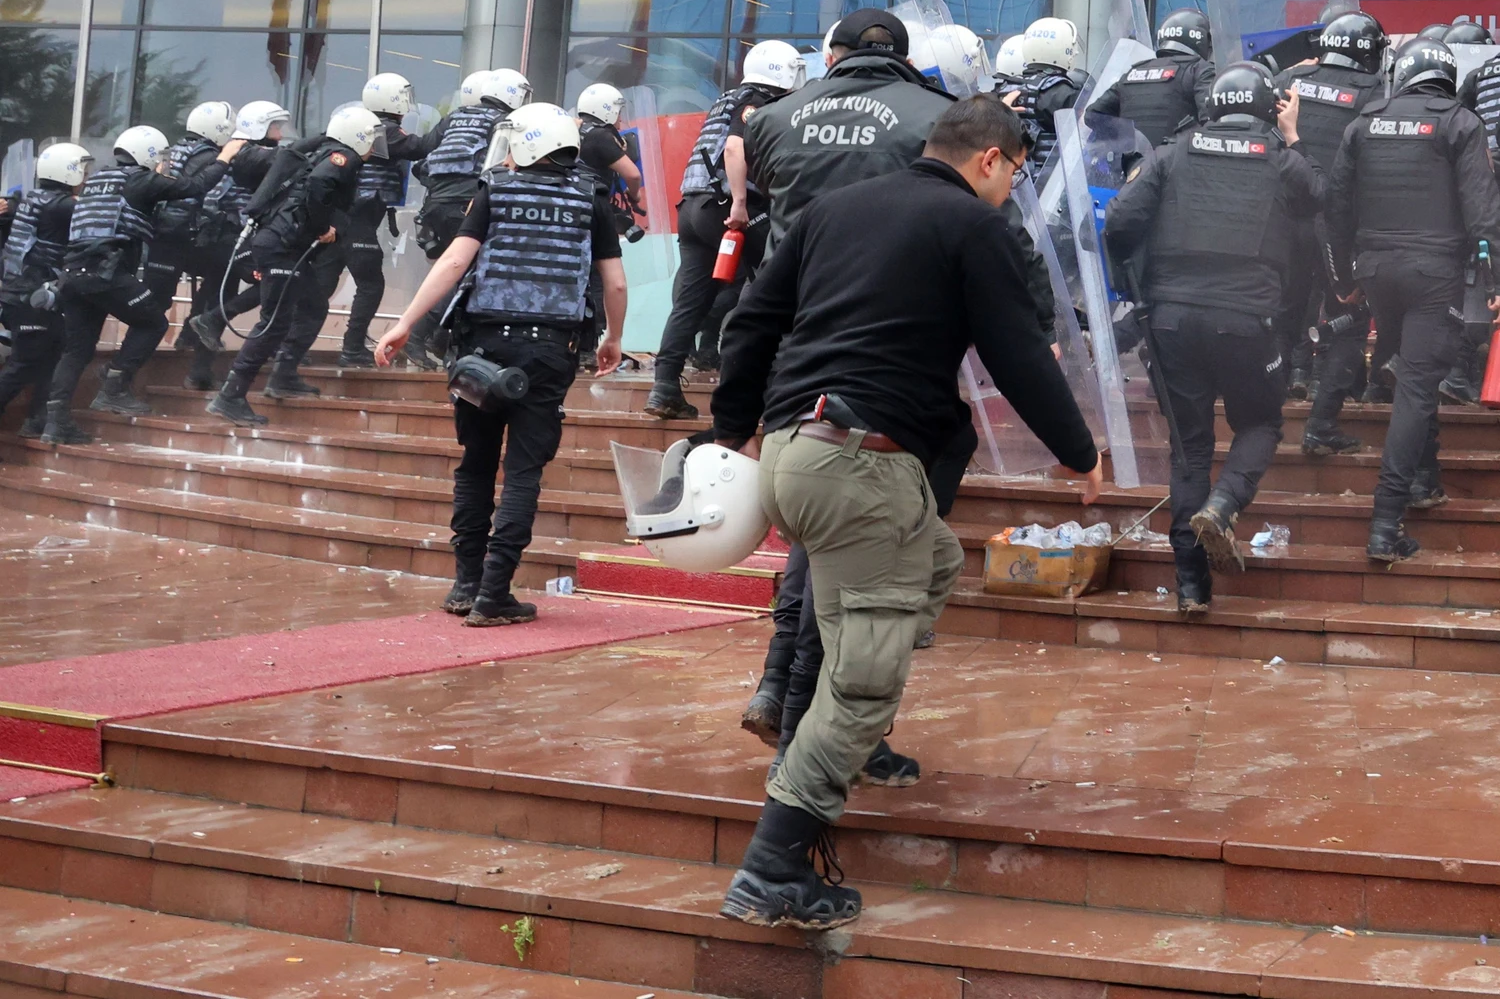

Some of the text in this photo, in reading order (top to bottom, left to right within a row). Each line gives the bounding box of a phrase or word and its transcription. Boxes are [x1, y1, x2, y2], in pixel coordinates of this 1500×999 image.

[1357, 38, 1370, 49] 06
[1212, 90, 1253, 106] T1505
[790, 96, 899, 131] ÇEVİK KUVVET
[525, 128, 542, 141] 06
[802, 124, 876, 145] POLİS
[511, 206, 574, 224] POLİS
